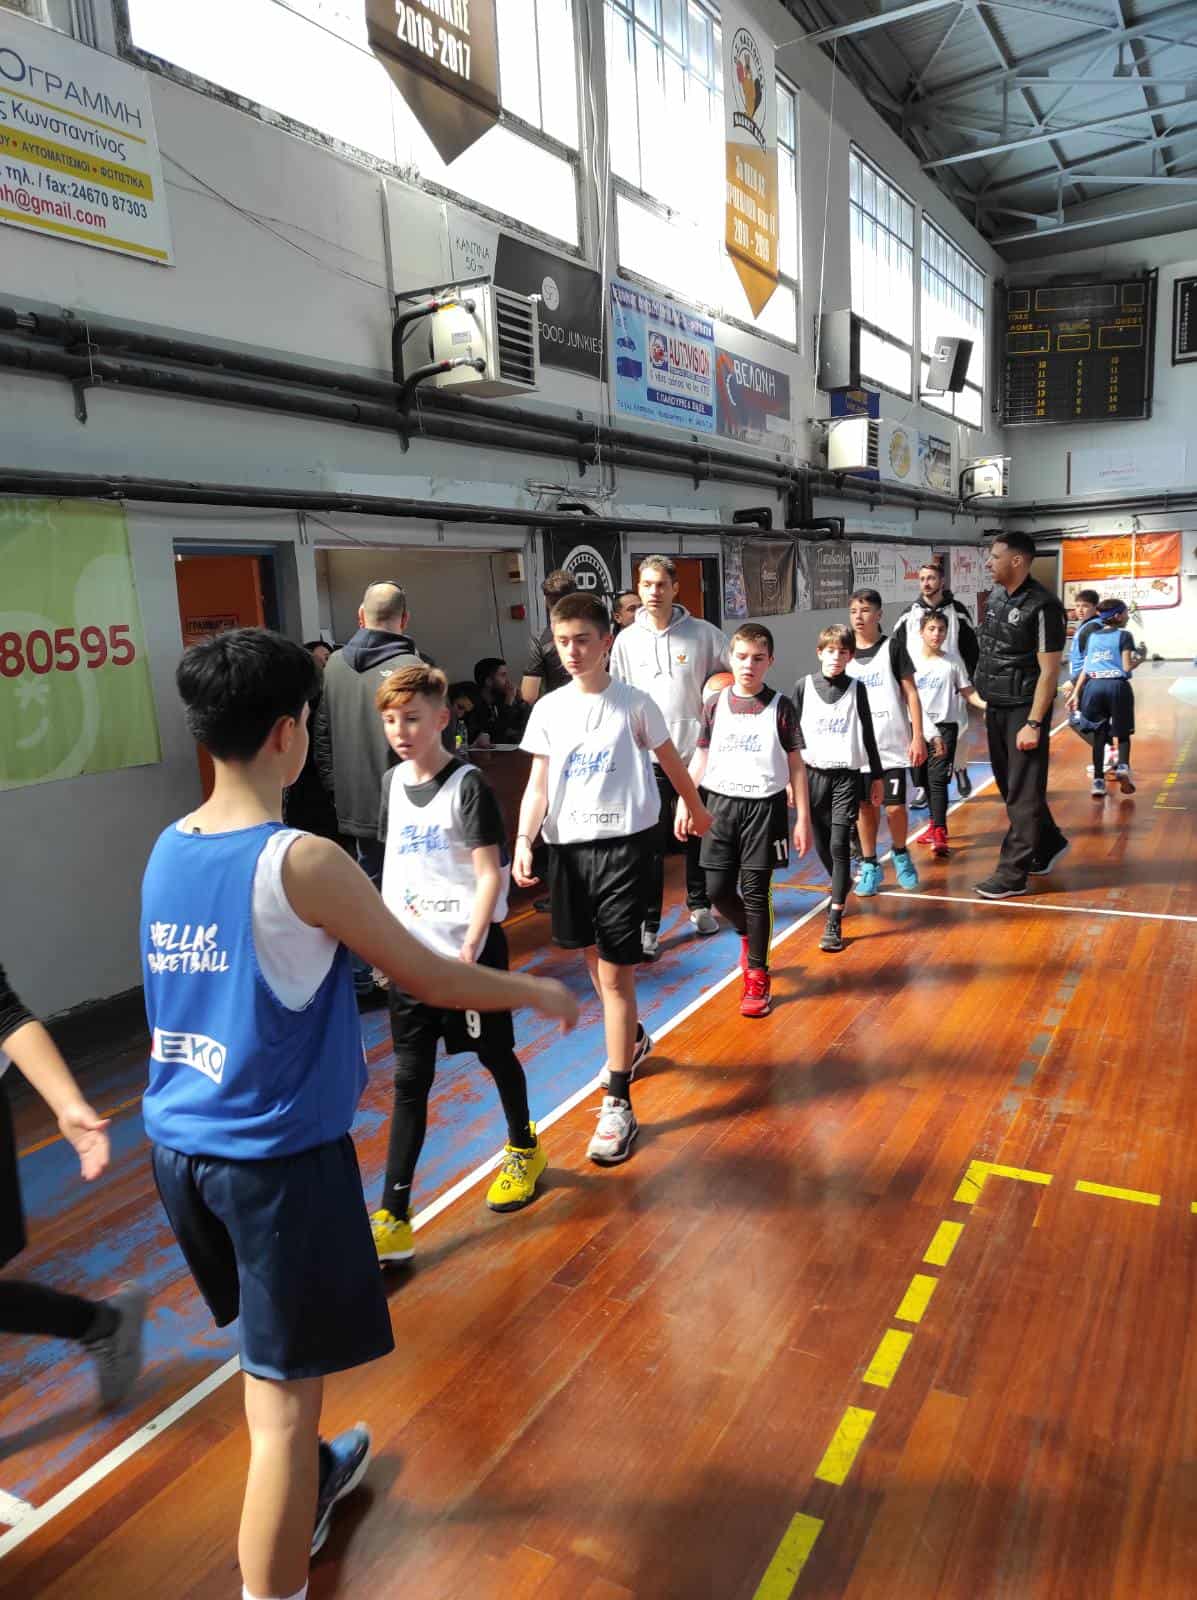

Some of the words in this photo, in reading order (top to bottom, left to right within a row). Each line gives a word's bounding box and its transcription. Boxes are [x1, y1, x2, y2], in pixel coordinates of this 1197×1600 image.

[395, 0, 471, 80] 2016-2017
[12, 100, 126, 161] Κωνσταντίνος
[22, 141, 90, 172] ΑΥΤΟΜΑΤΙΣΜΟΙ
[46, 175, 108, 207] fax:24670
[112, 198, 148, 218] 87303
[669, 336, 710, 377] AUTOVISION
[0, 624, 136, 678] 80595
[889, 778, 900, 795] 7
[773, 838, 789, 861] 11
[150, 921, 218, 952] HELLAS
[465, 1009, 481, 1039] 9
[160, 1034, 223, 1074] EKO
